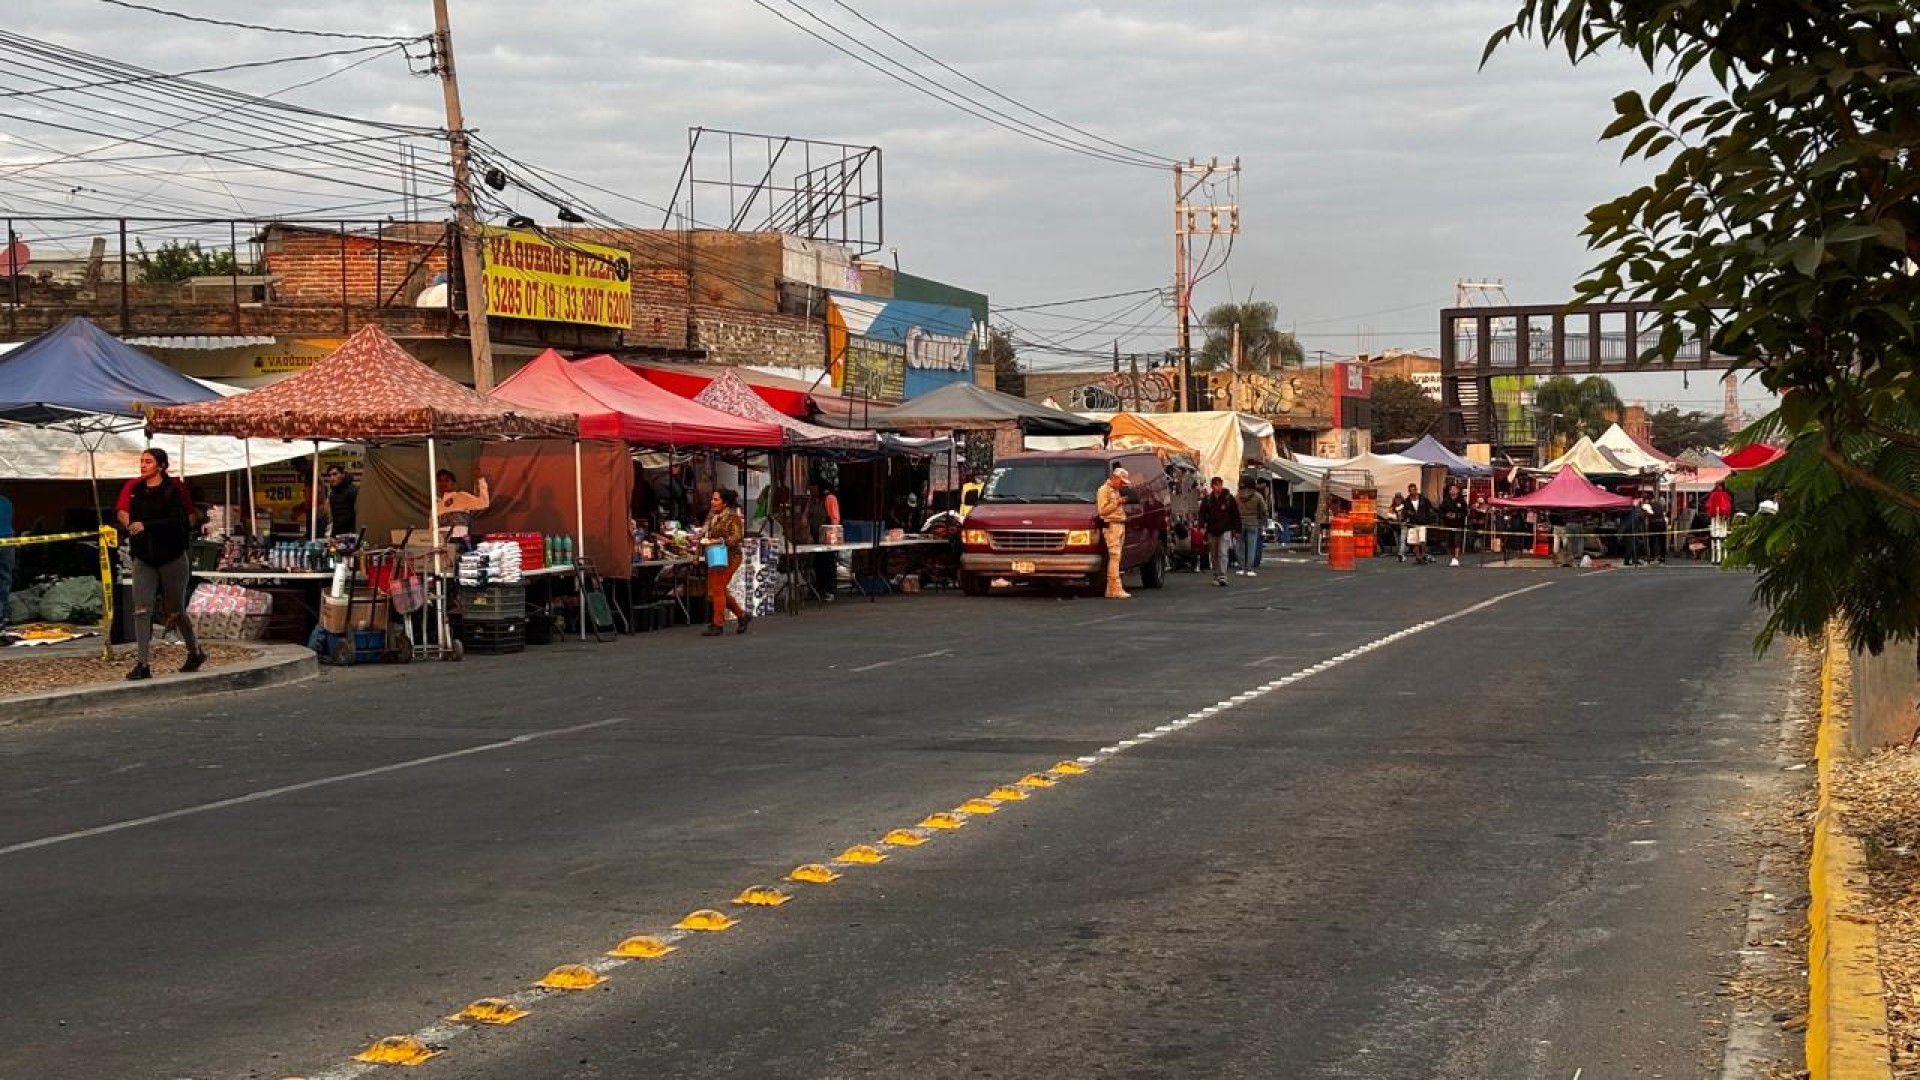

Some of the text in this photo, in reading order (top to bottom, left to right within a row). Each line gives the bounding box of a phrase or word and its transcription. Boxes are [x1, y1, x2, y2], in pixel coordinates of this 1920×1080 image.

[491, 237, 571, 275] VAQUEROS
[493, 275, 522, 315] 3285
[526, 280, 538, 316] 07
[565, 285, 577, 320] 33
[580, 288, 604, 323] 3607
[607, 291, 631, 325] 6200
[906, 325, 973, 372] Comex
